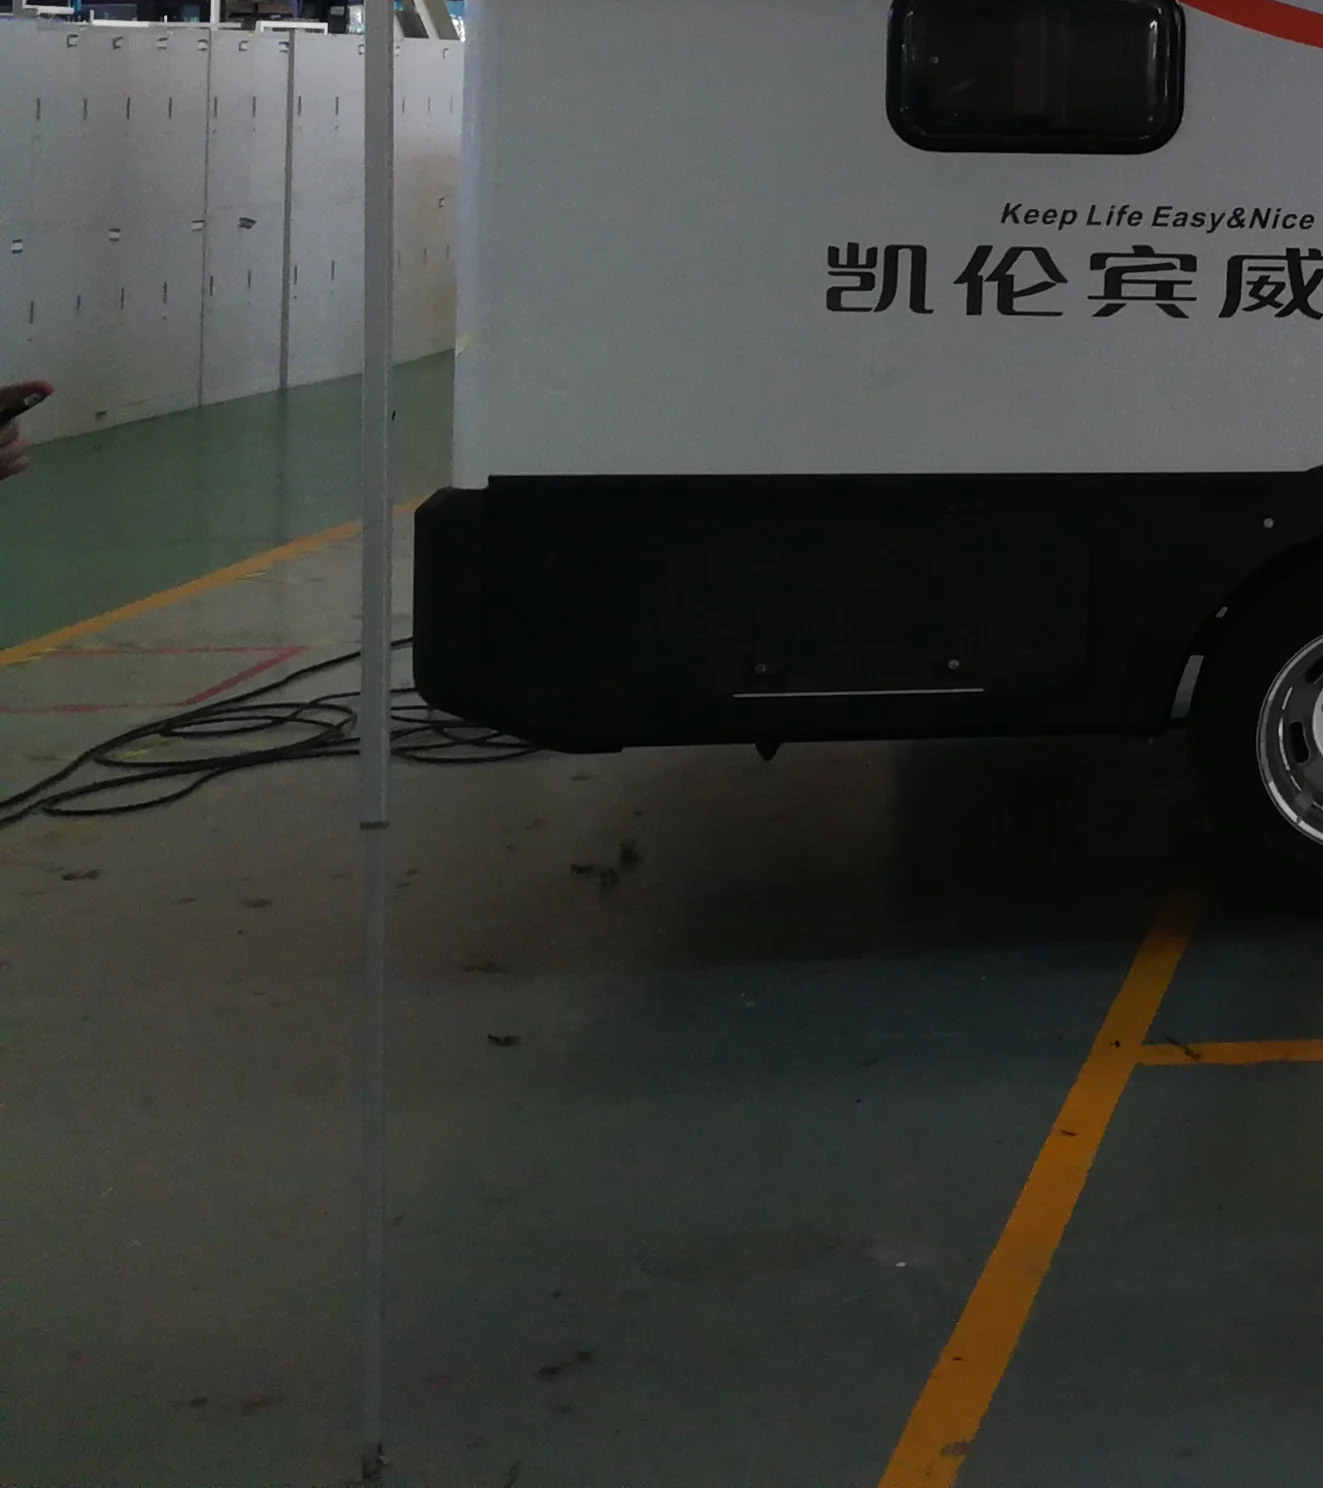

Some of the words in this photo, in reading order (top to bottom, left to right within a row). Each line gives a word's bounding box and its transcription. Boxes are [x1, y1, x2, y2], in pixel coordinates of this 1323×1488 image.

[1000, 202, 1078, 230] Keep
[1085, 204, 1144, 227] Life
[1151, 206, 1316, 234] Easy&Nice
